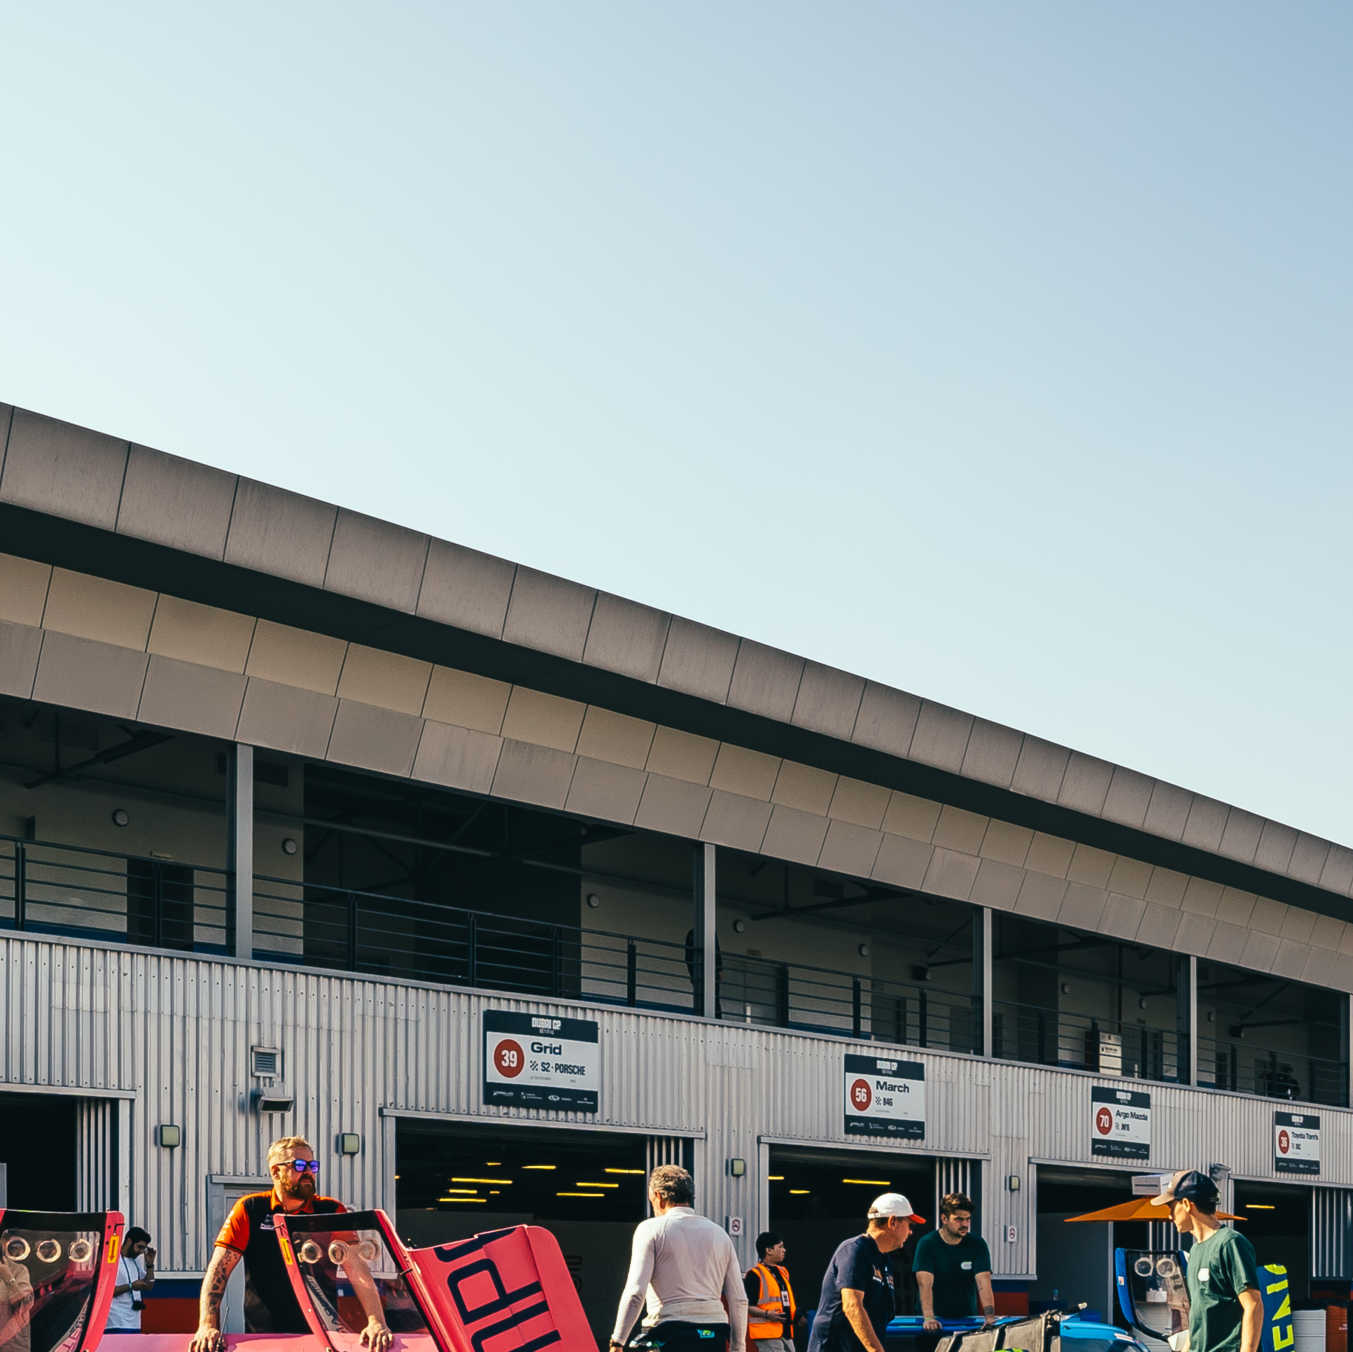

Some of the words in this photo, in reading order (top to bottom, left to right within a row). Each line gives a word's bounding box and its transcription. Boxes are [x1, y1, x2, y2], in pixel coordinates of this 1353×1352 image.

[531, 1042, 562, 1055] Grid
[501, 1050, 518, 1068] 39
[876, 1080, 910, 1093] March
[855, 1087, 867, 1102] 56
